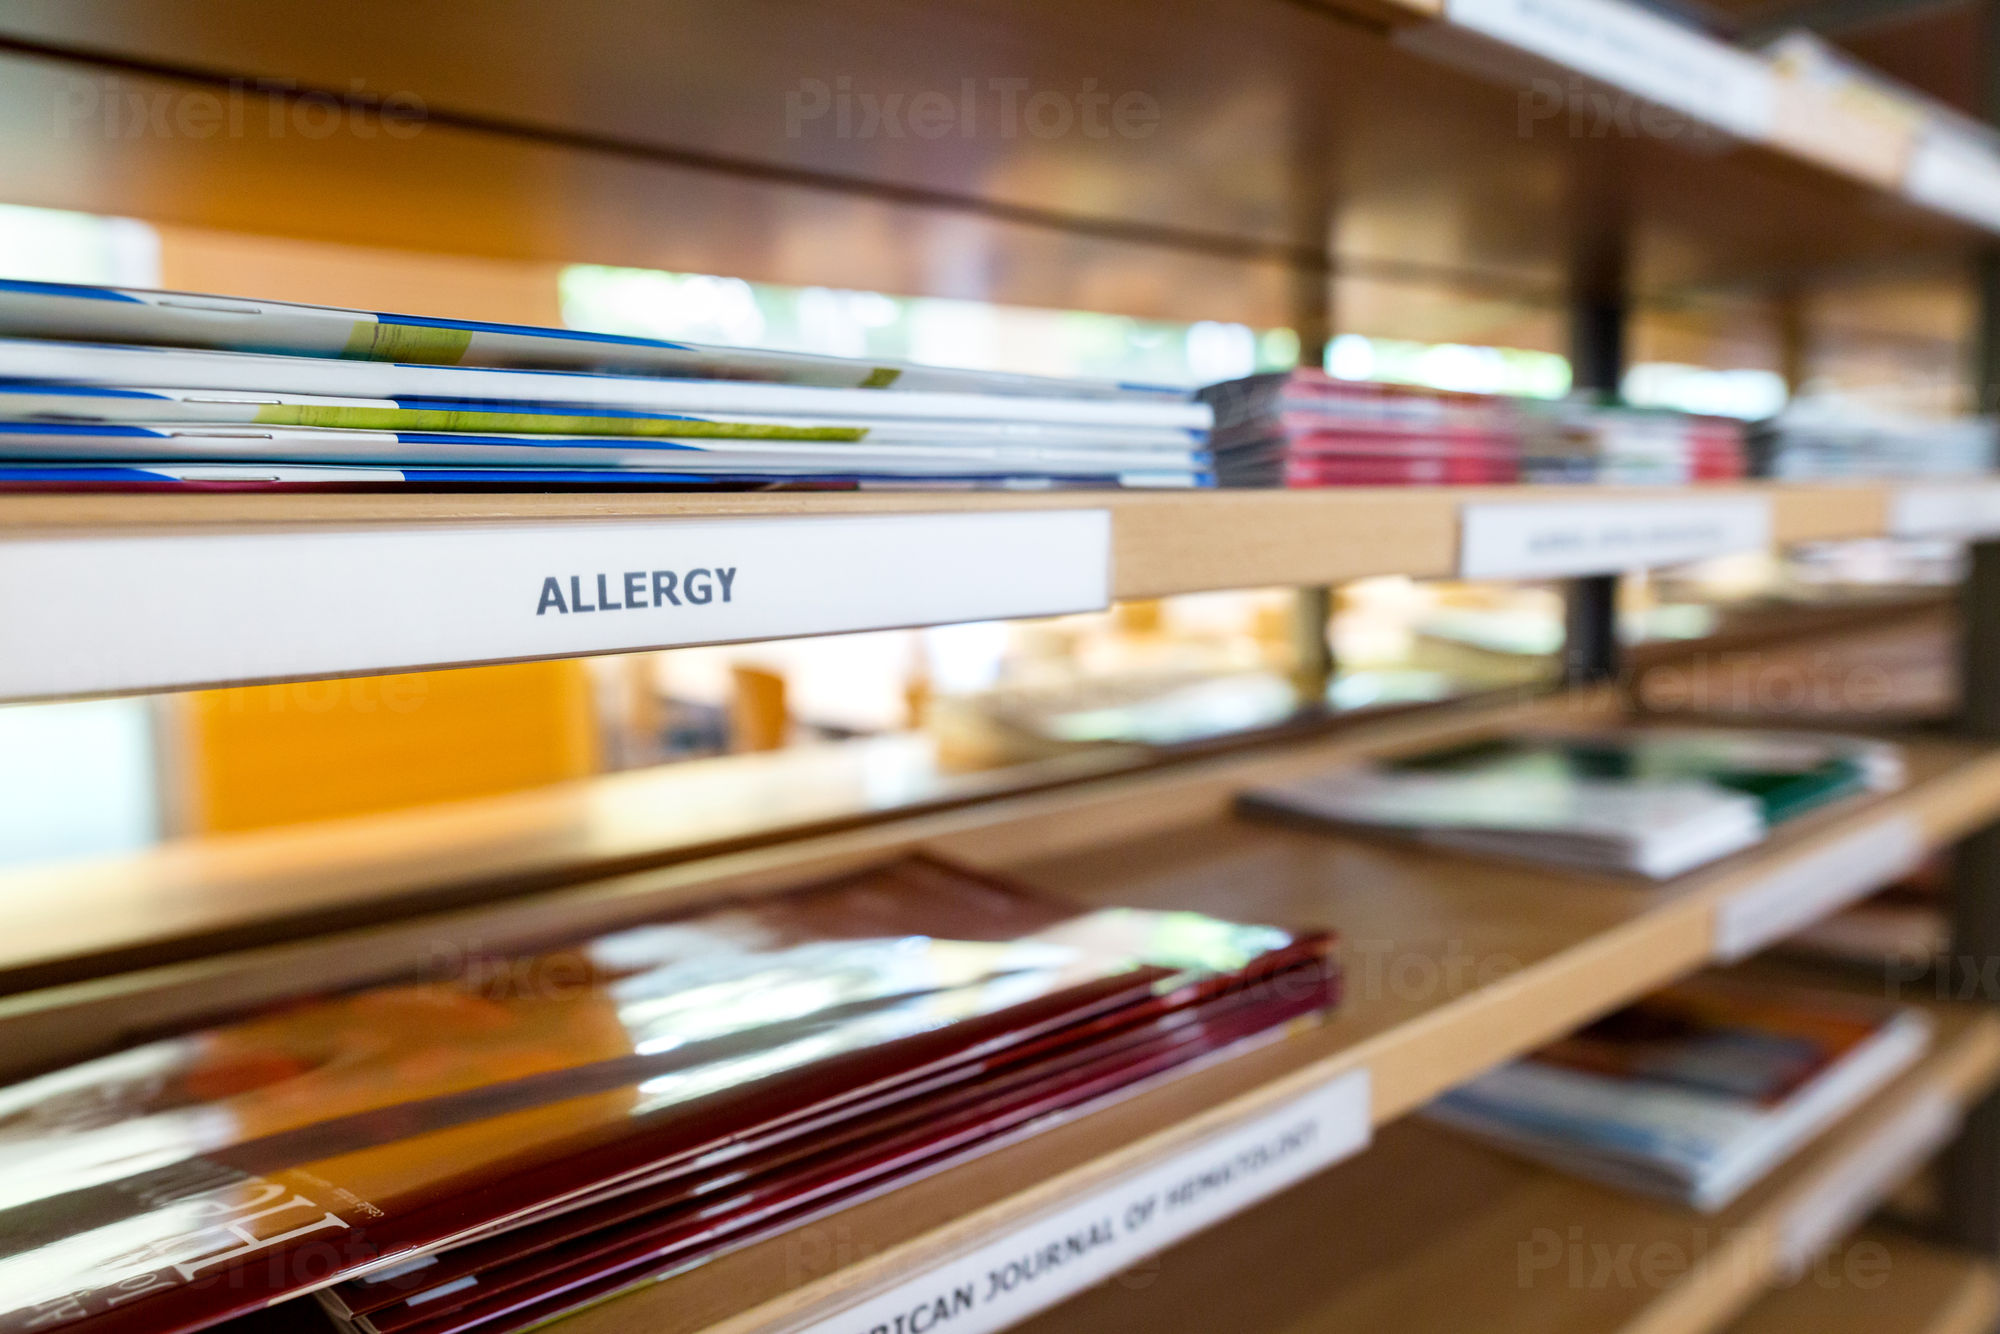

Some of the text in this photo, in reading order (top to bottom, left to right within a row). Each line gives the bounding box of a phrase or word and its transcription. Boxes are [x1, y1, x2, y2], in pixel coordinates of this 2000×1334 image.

[536, 567, 737, 615] ALLERGY
[985, 1217, 1114, 1302] JOURNAL
[1124, 1195, 1156, 1232] OF
